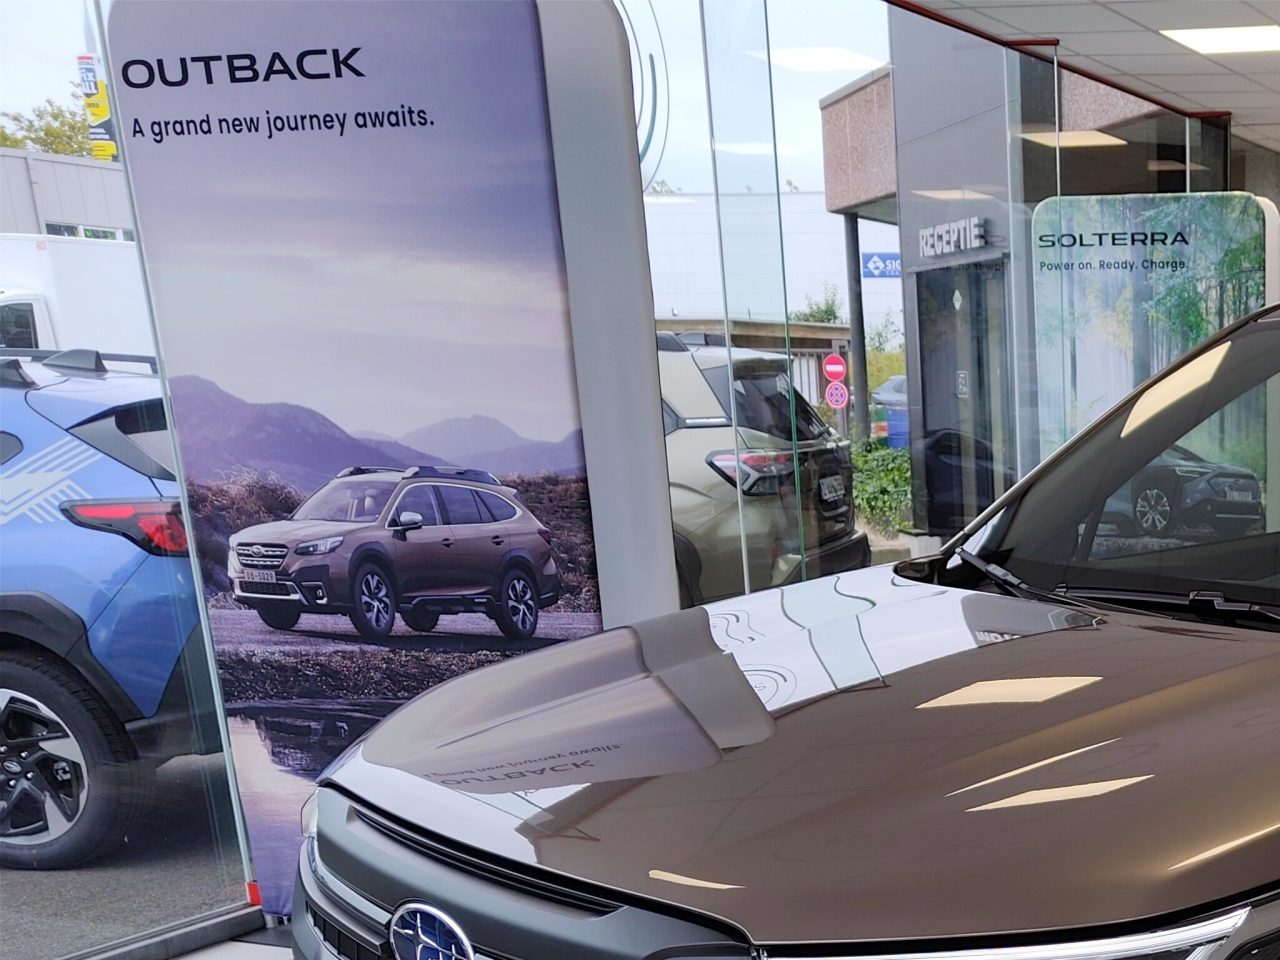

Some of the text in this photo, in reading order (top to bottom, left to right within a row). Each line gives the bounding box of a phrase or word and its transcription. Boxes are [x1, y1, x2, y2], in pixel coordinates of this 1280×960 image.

[121, 46, 366, 89] OUTBACK
[132, 104, 435, 144] A grand new journey awaits.
[919, 216, 983, 257] RECEPTIE
[1038, 231, 1189, 248] SOLTERRA
[1039, 259, 1188, 272] Power on. Ready. Charge.
